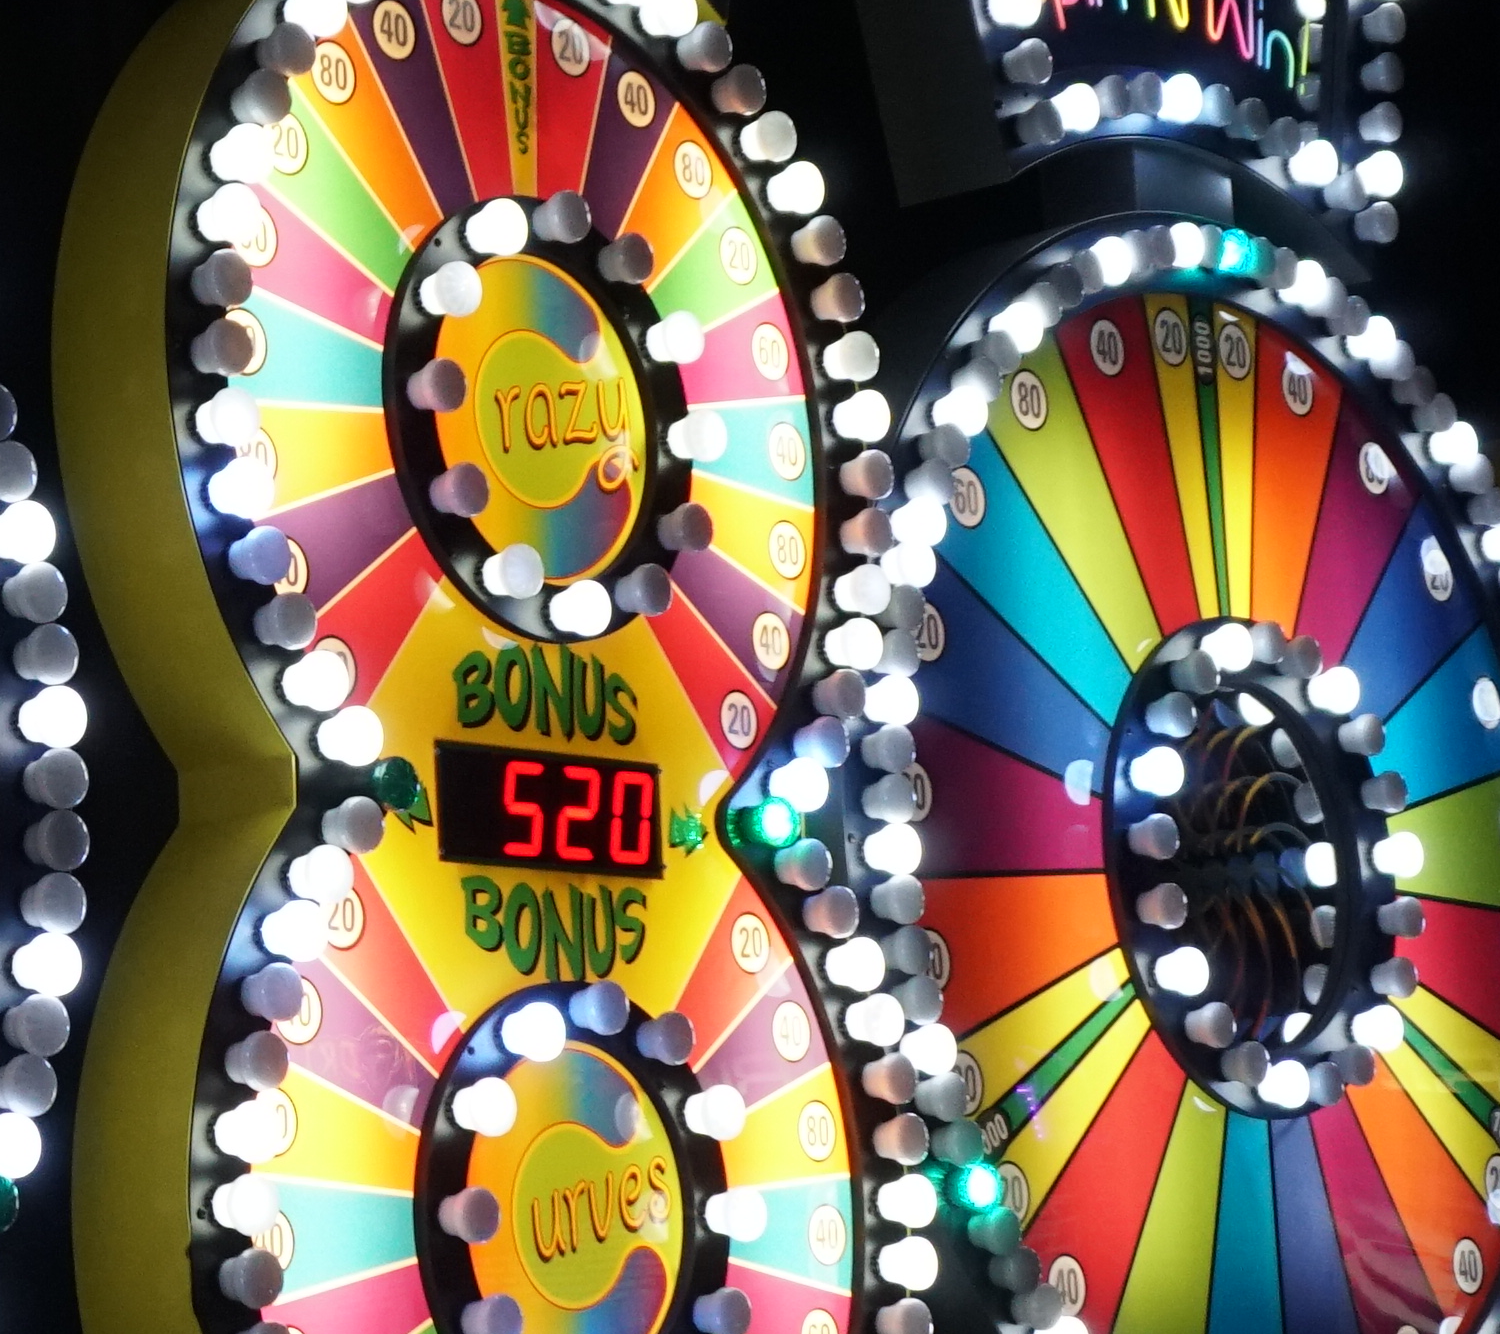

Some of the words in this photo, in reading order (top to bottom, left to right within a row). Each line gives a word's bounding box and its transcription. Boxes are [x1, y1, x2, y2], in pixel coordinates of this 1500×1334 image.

[381, 11, 407, 46] 40
[449, 0, 475, 32] 20
[559, 31, 583, 64] 20
[321, 54, 347, 90] 80
[505, 33, 531, 156] BONUS
[625, 83, 647, 115] 40
[682, 154, 704, 186] 80
[1097, 330, 1118, 365] 40
[1160, 320, 1182, 355] 20
[1194, 323, 1212, 375] 1000
[1225, 334, 1246, 368] 20
[1018, 382, 1041, 418] 80
[1288, 374, 1307, 405] 40
[778, 535, 798, 565] 80
[760, 625, 782, 655] 40
[453, 643, 637, 746] BONUS
[728, 703, 751, 736] 20
[503, 760, 653, 866] 520
[461, 875, 647, 981] BONUS
[740, 927, 760, 957] 20
[808, 1116, 828, 1146] 80
[1460, 1249, 1479, 1282] 40
